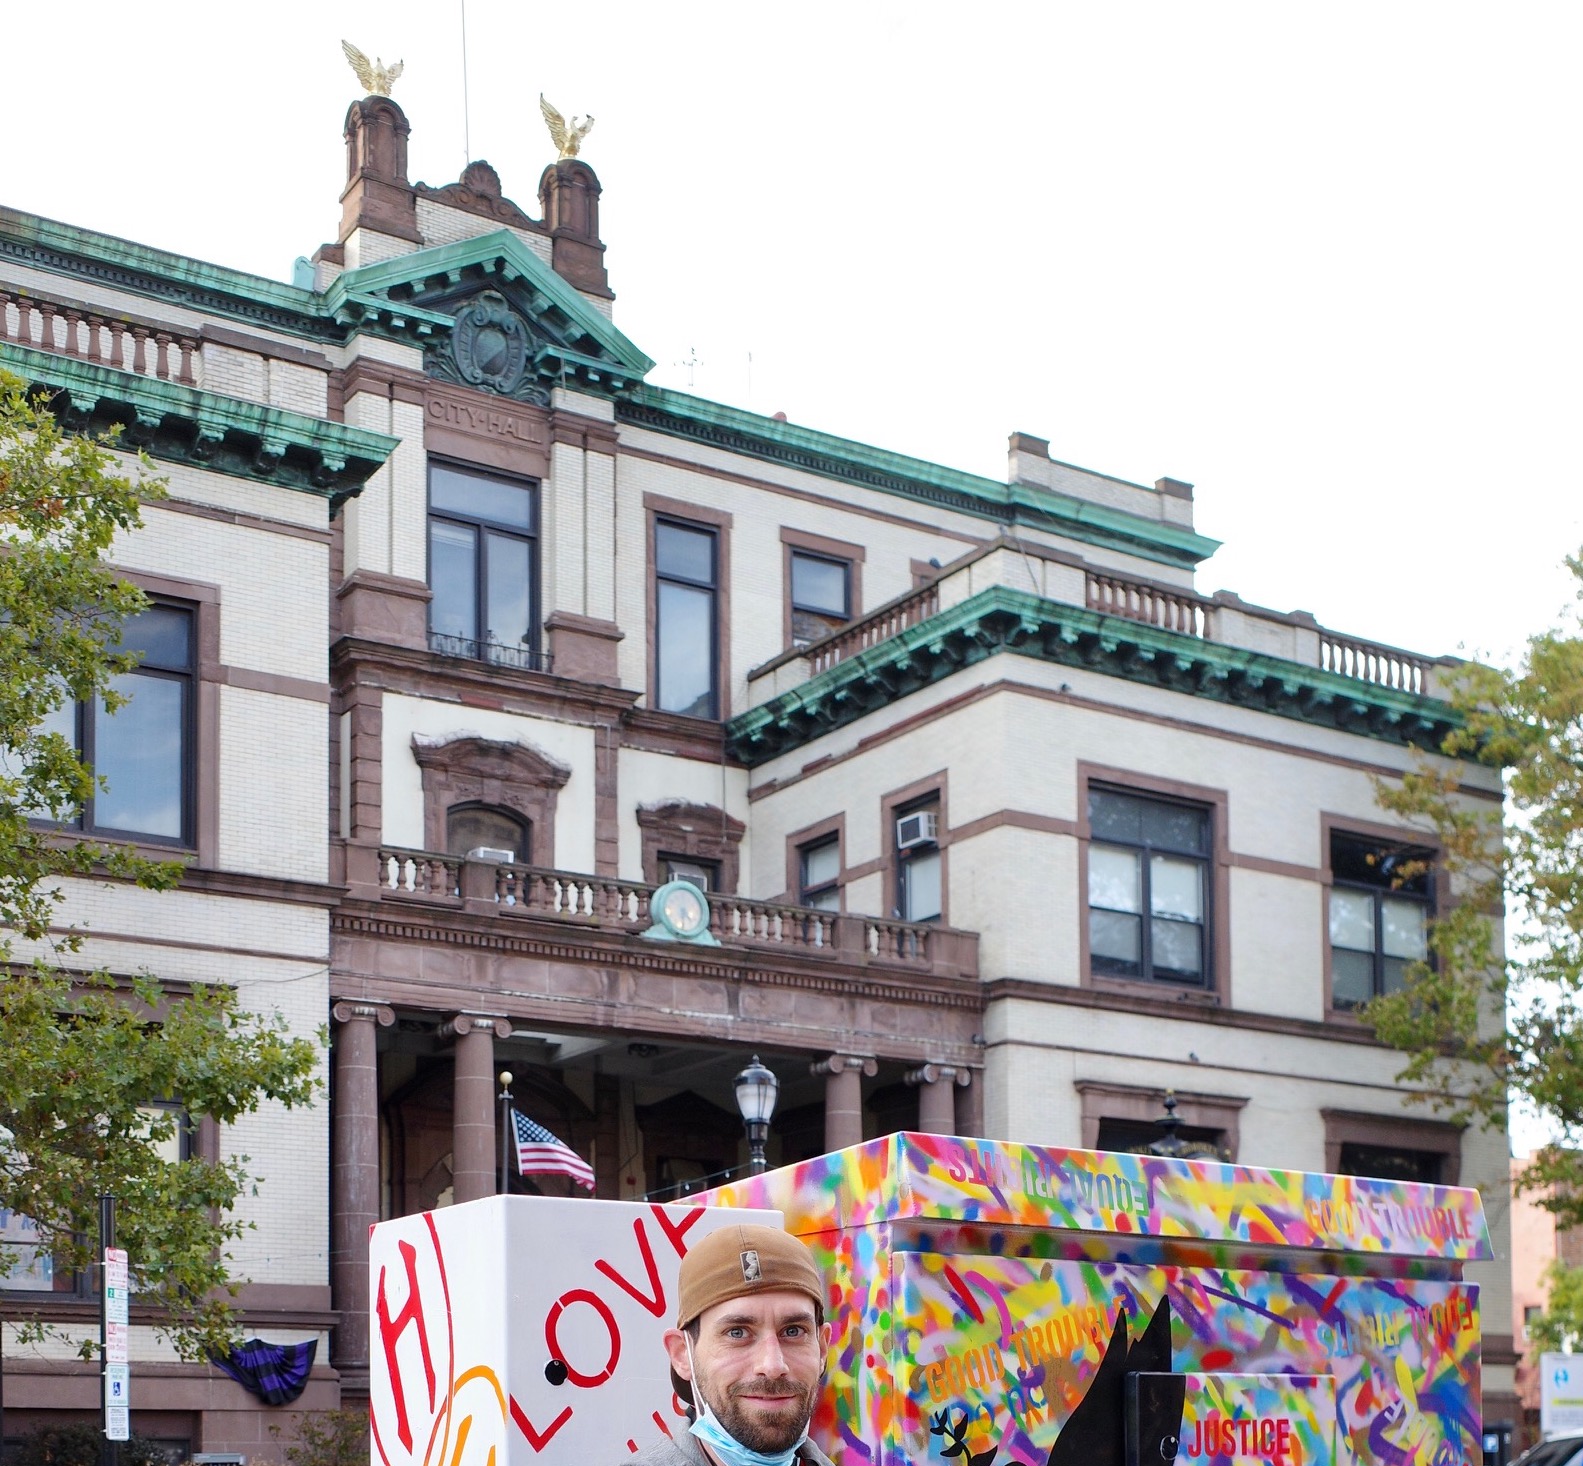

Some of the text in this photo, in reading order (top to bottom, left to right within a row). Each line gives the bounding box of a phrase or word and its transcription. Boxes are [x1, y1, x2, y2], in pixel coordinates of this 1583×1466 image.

[1061, 1163, 1150, 1217] EQUAL
[924, 1340, 1005, 1404] GOOD
[1187, 1418, 1291, 1459] JUSTICE
